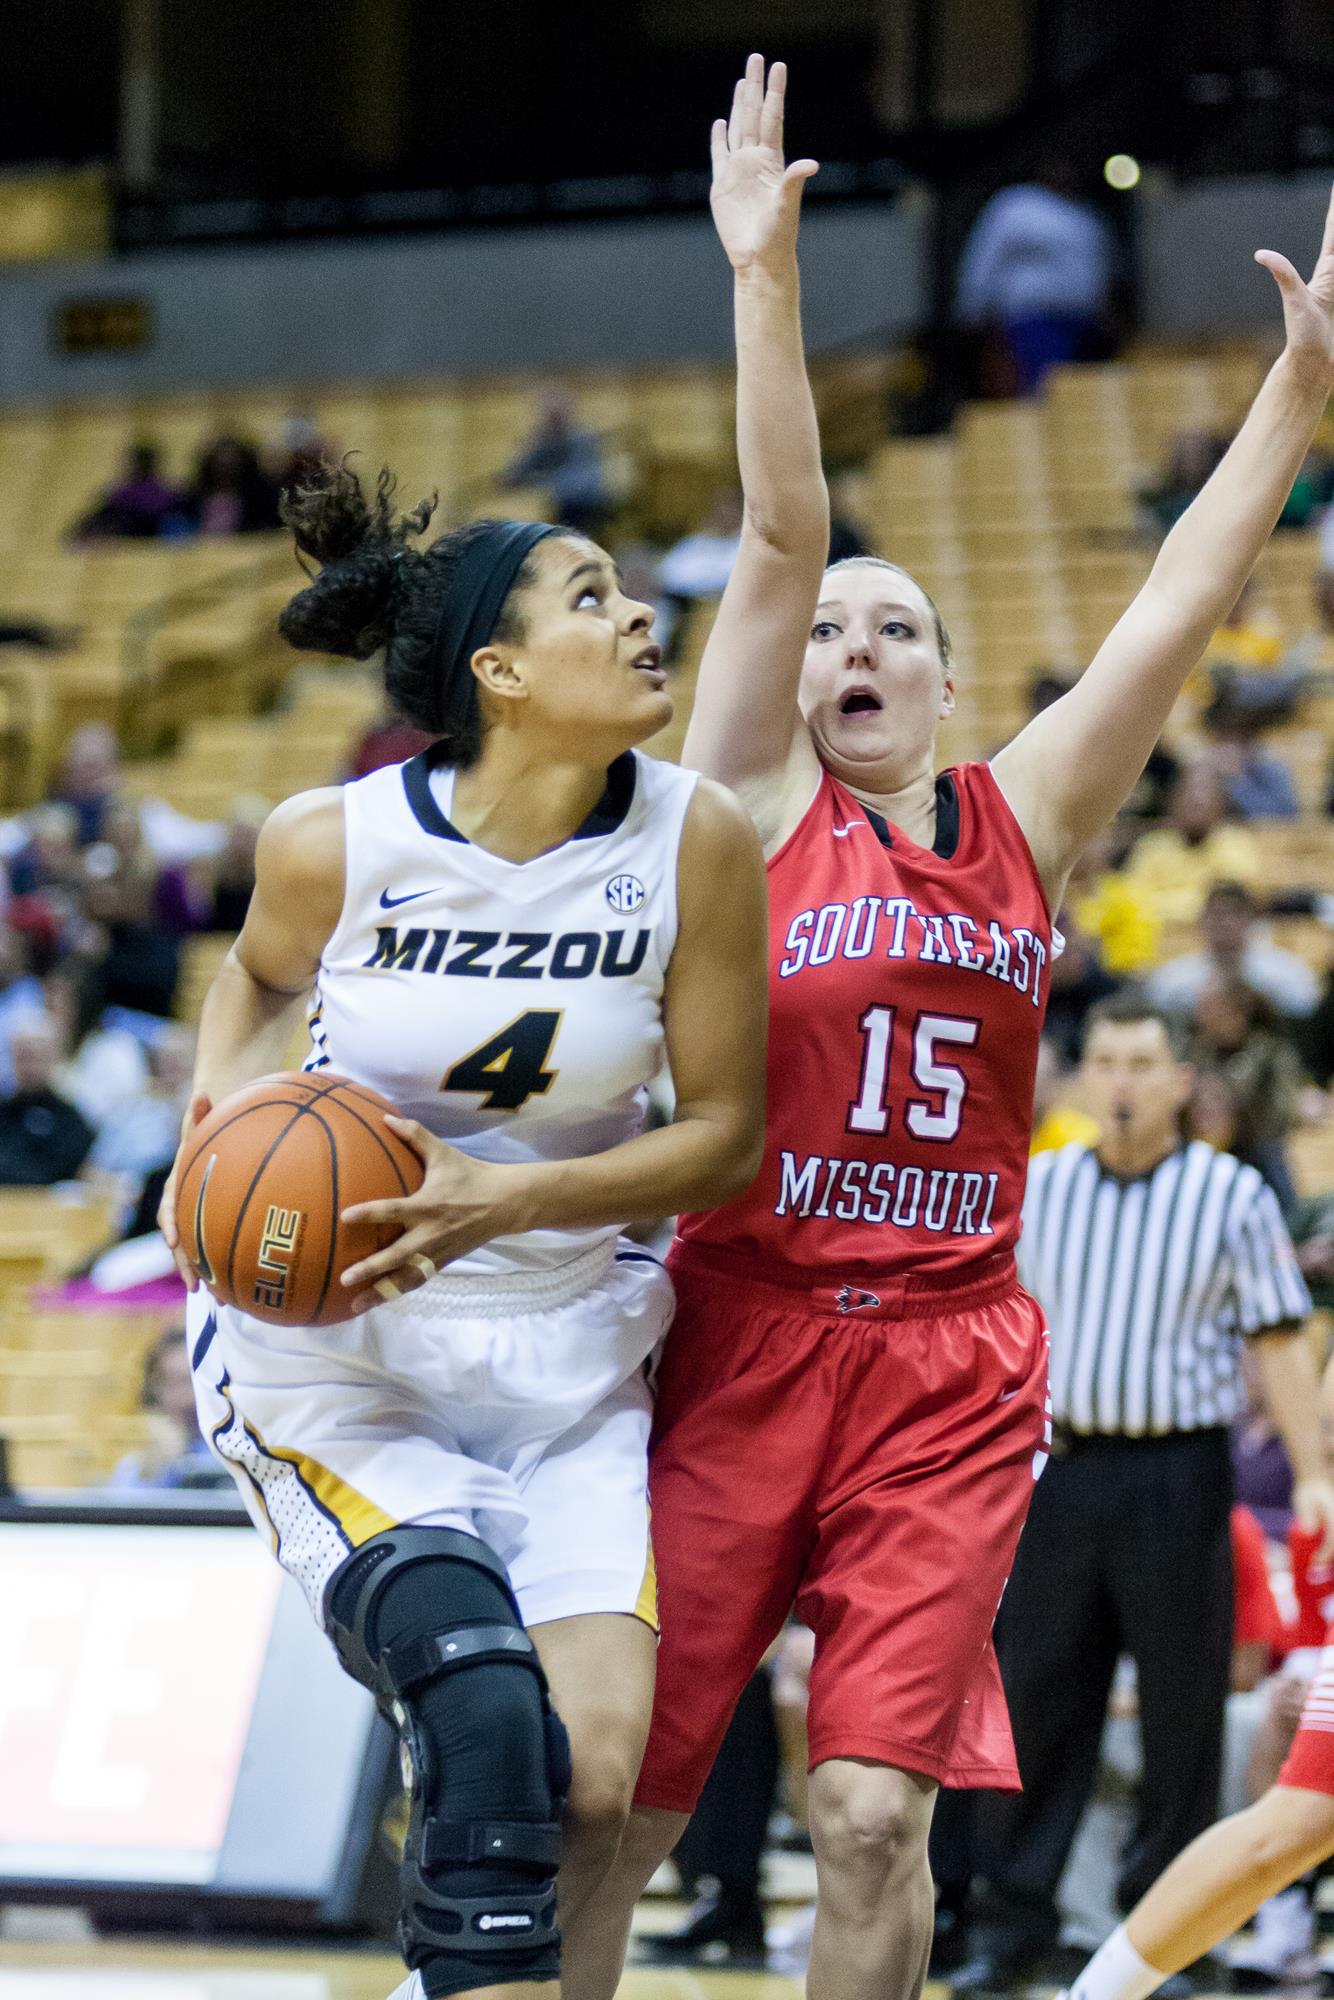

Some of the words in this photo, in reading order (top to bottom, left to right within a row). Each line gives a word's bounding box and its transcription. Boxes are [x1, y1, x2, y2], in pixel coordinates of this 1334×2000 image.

[607, 875, 644, 912] SEC
[362, 927, 652, 979] MIZZOU
[779, 897, 1047, 1007] SOUTHEAST
[440, 1008, 565, 1113] 4
[846, 1004, 981, 1142] 15
[775, 1150, 999, 1236] MISSOURI
[254, 1205, 300, 1310] ELITE
